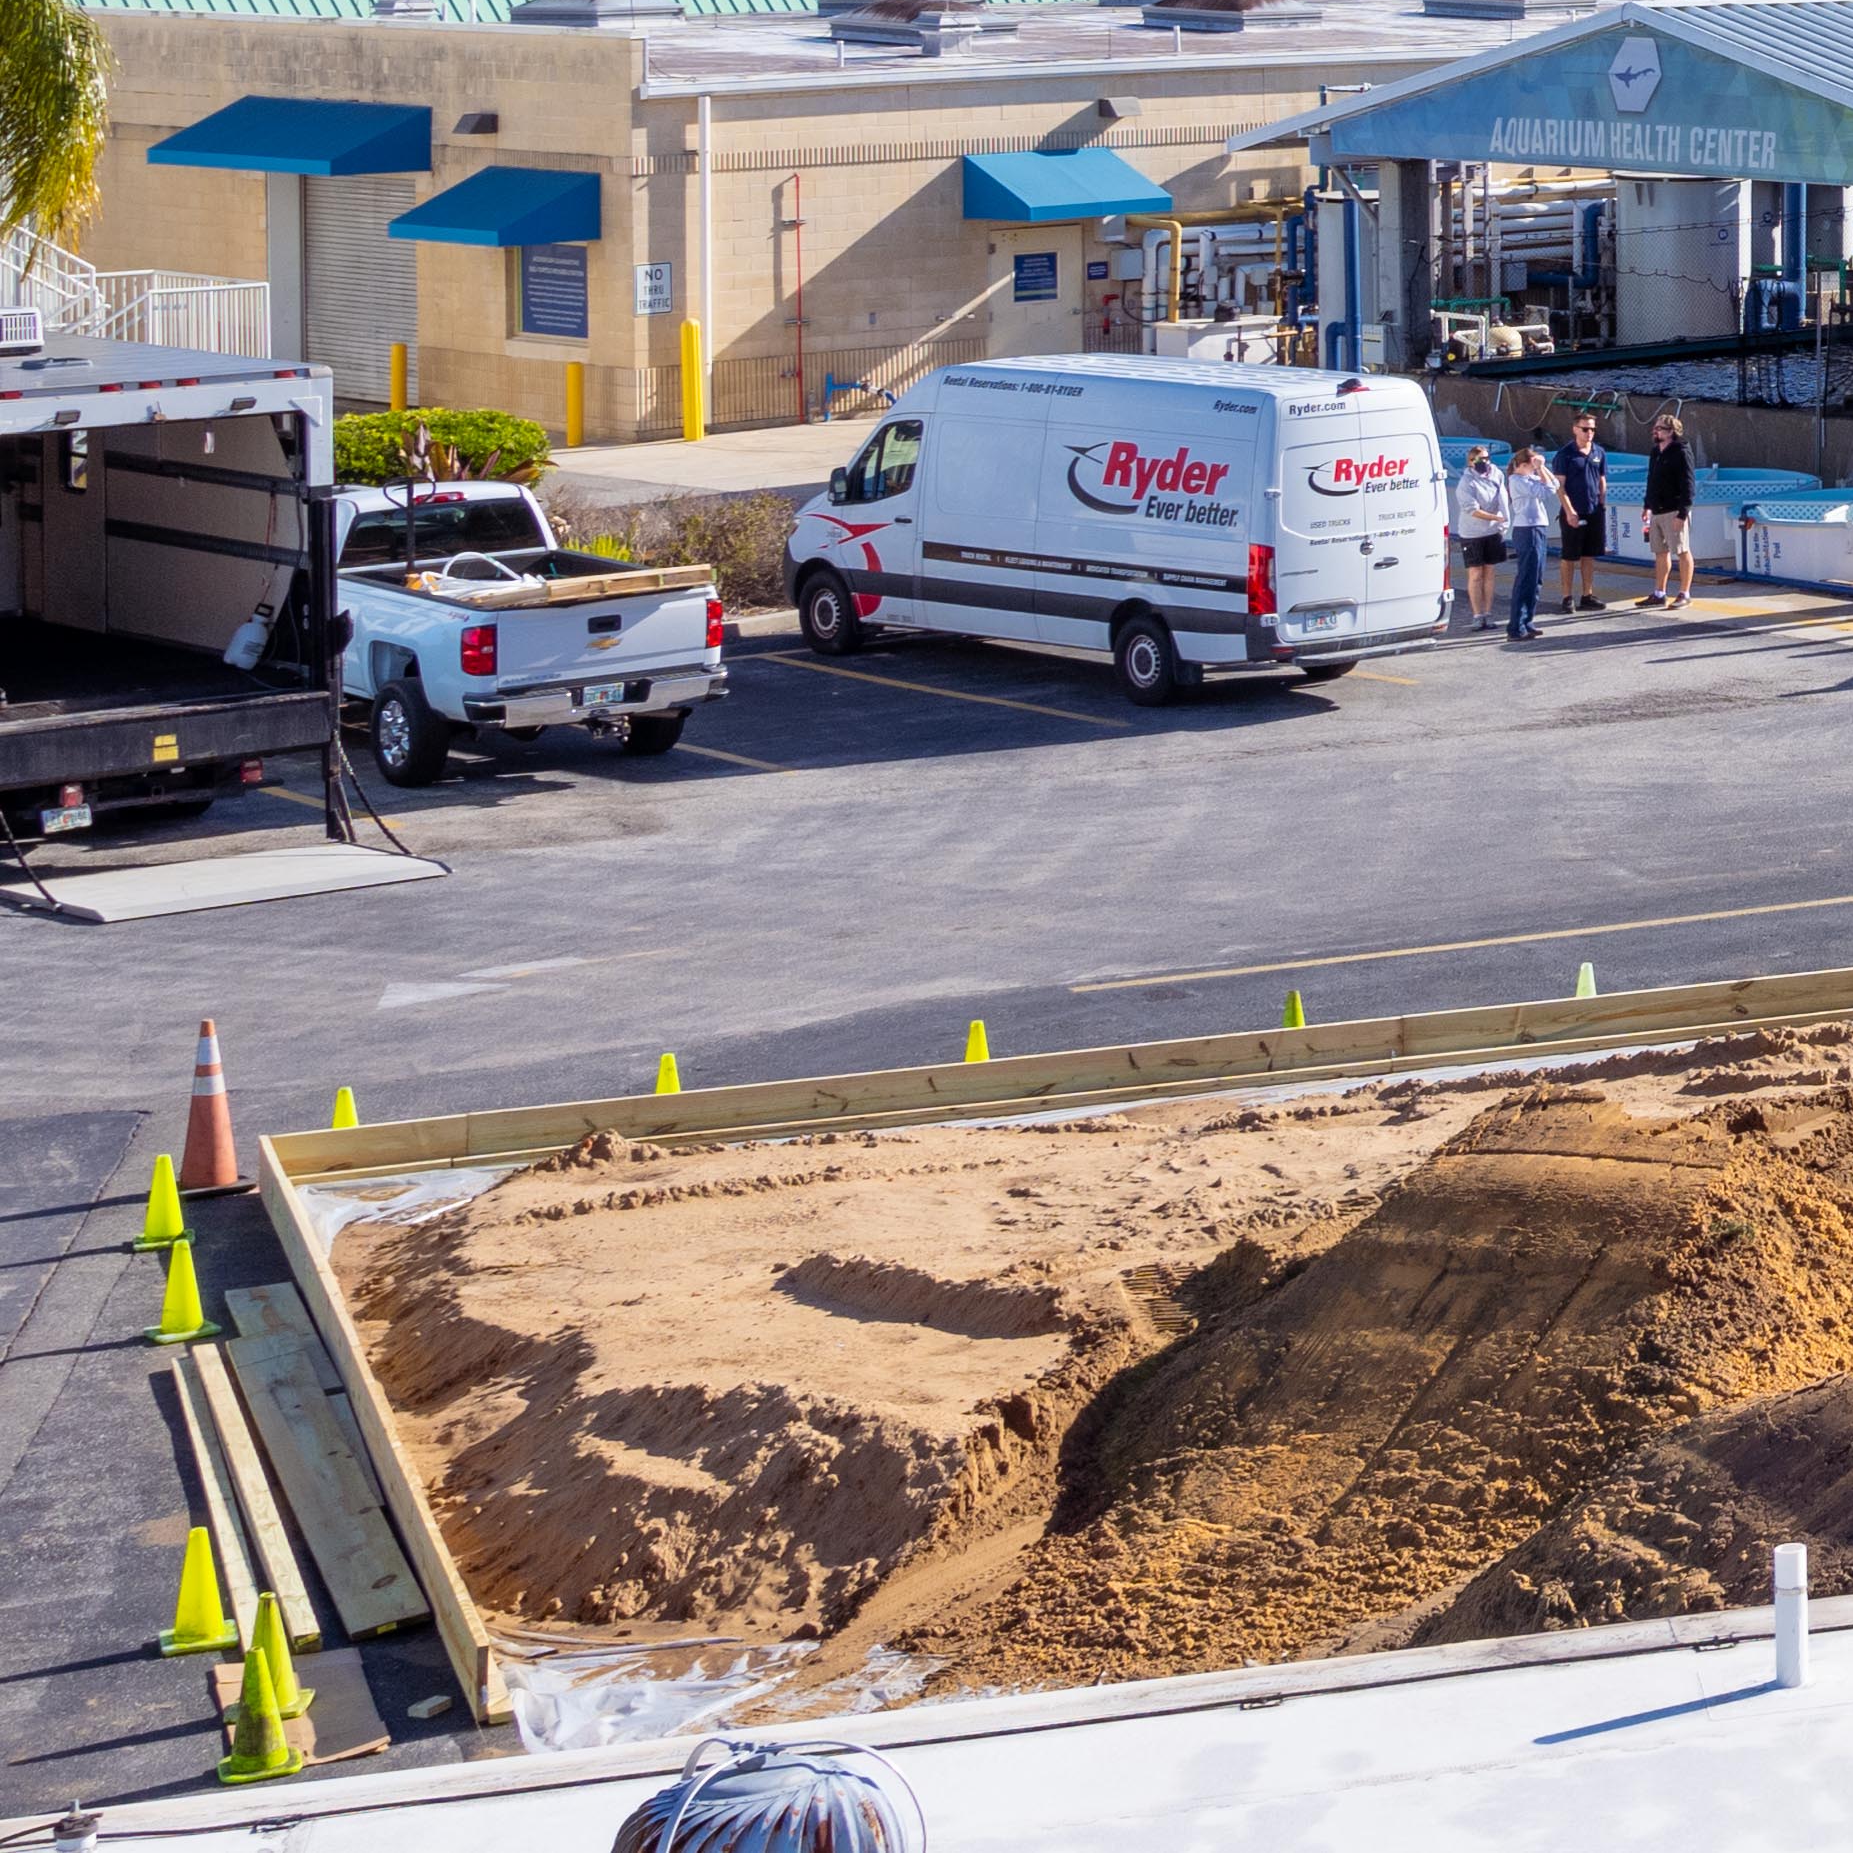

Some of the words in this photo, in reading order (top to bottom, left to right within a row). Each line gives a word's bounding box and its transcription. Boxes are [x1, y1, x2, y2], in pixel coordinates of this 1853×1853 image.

[1490, 117, 1605, 157] AQUARIUM
[1610, 122, 1681, 163] HEALTH
[1689, 126, 1777, 170] CENTER
[645, 269, 664, 281] NO
[643, 285, 665, 295] THRU
[639, 298, 670, 309] TRAFFIC
[944, 375, 969, 387] Rental
[1213, 399, 1257, 415] Ryder.com
[1289, 401, 1346, 417] Ryder.com
[1102, 441, 1230, 500] Ryder
[1334, 455, 1409, 486] Ryder
[1365, 481, 1388, 494] Ever
[1390, 478, 1419, 491] better.
[1145, 495, 1183, 522] Ever
[1184, 499, 1239, 528] better.
[1622, 522, 1631, 539] Pool
[1774, 542, 1782, 559] Pool
